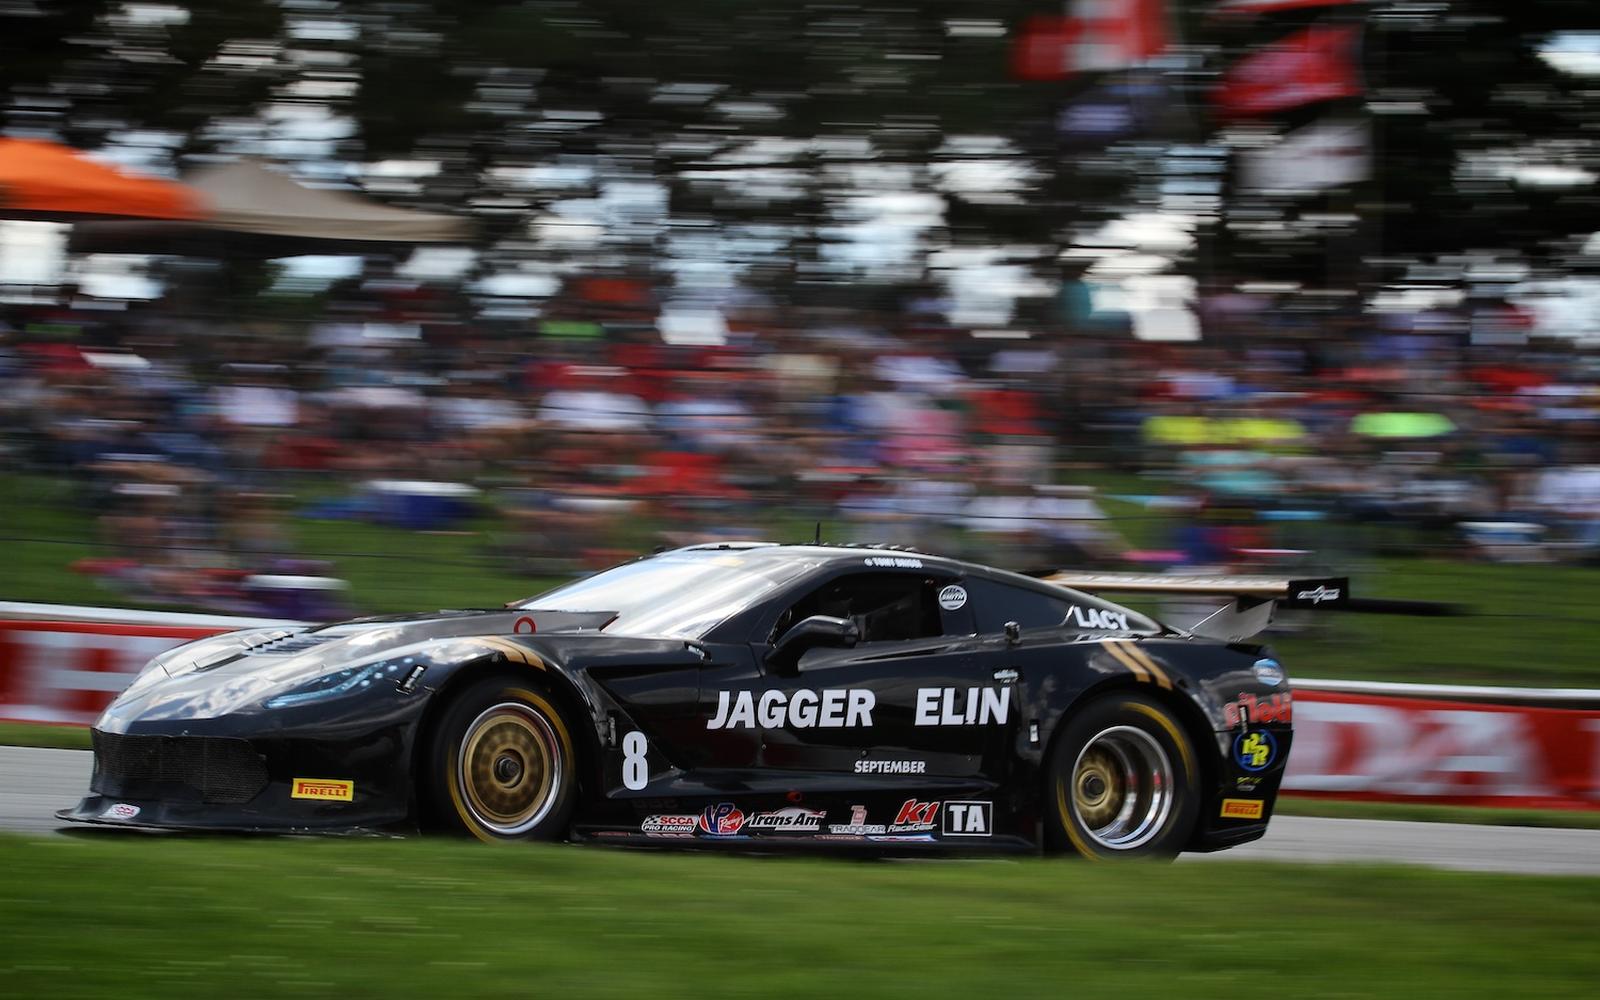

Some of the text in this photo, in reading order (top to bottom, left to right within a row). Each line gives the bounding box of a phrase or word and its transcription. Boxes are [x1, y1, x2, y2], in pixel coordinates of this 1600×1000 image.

[1073, 606, 1130, 631] LACY
[706, 687, 1011, 730] JAGGER ELIN
[622, 730, 649, 791] 8
[854, 760, 926, 774] SEPTEMBER
[297, 782, 349, 797] PIRELLI
[660, 816, 694, 825] SCCA
[895, 799, 941, 825] K1
[949, 805, 986, 833] TA
